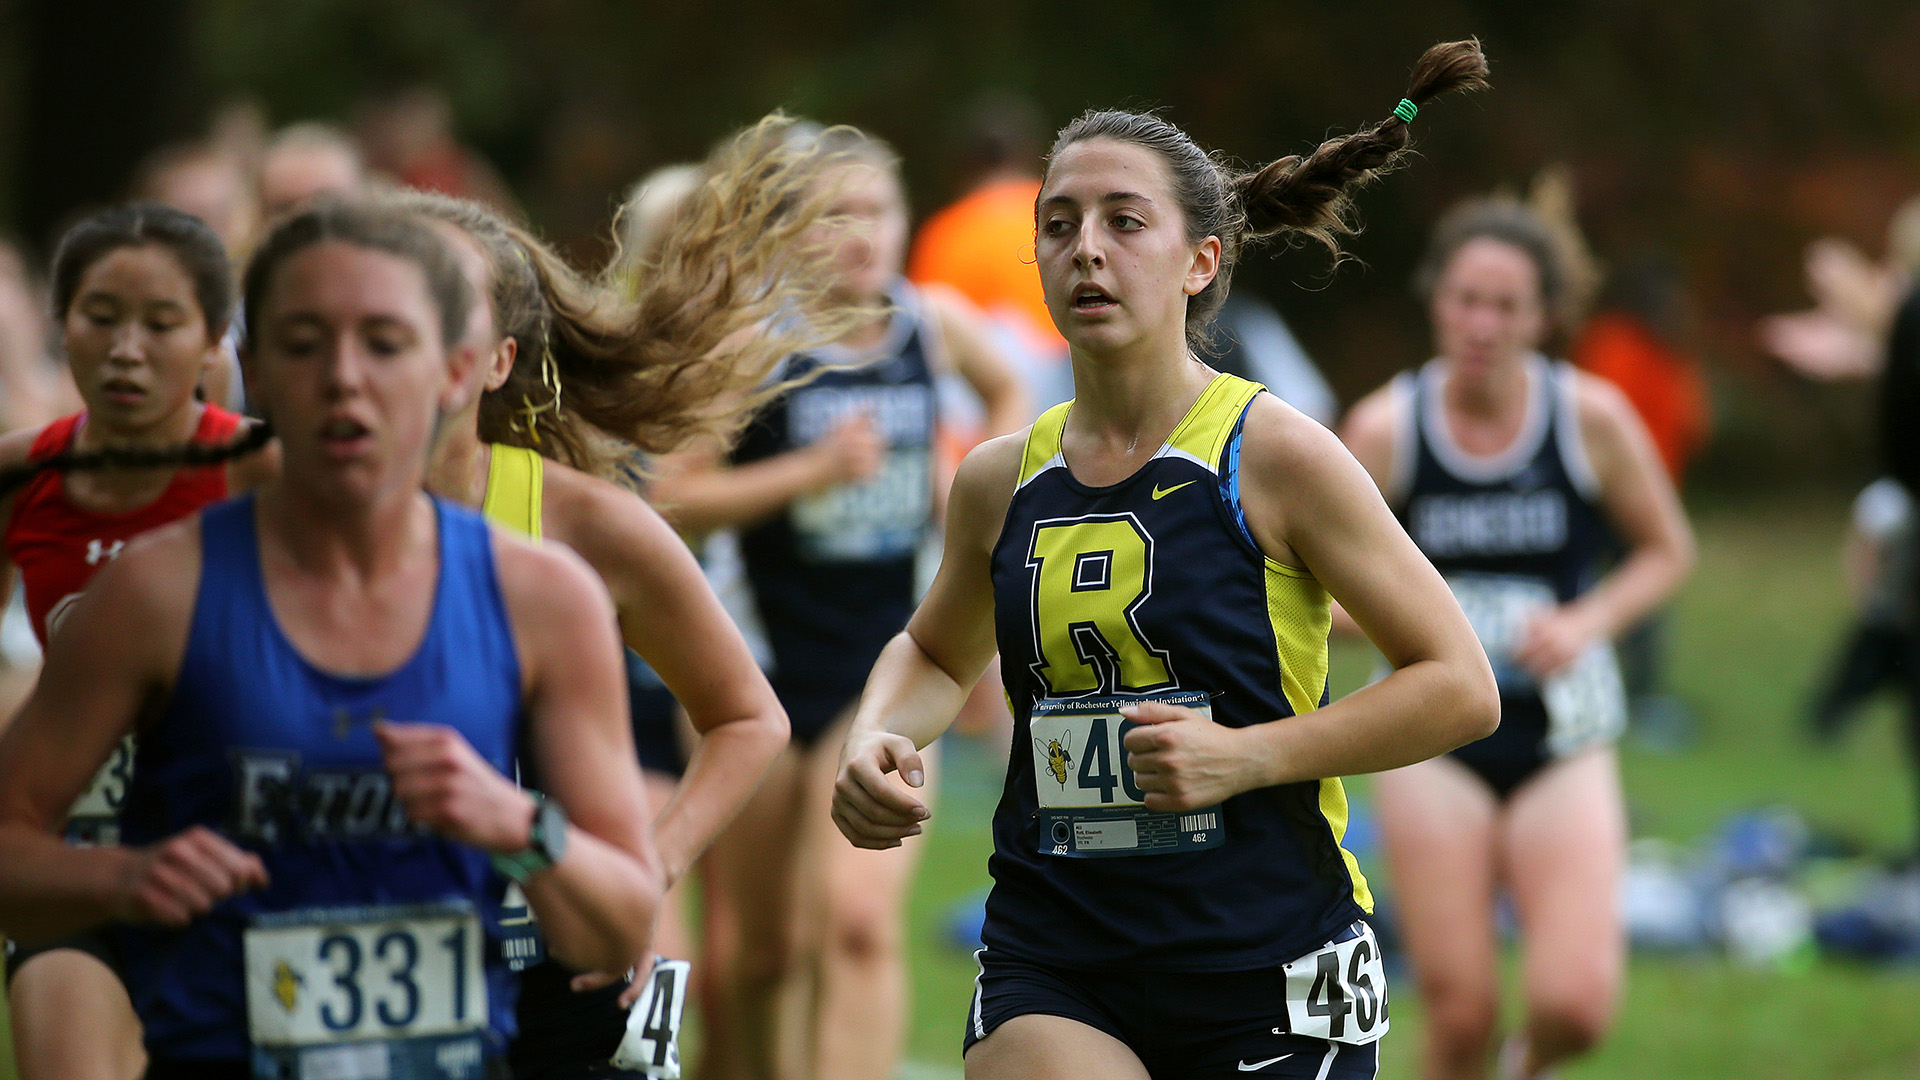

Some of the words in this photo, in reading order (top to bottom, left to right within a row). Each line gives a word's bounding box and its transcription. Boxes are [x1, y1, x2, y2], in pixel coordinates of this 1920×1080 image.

[1025, 512, 1180, 701] R
[1067, 701, 1074, 709] of
[1075, 701, 1110, 709] Rochester
[1191, 832, 1207, 843] 462
[1051, 844, 1068, 855] 462
[317, 928, 466, 1031] 331
